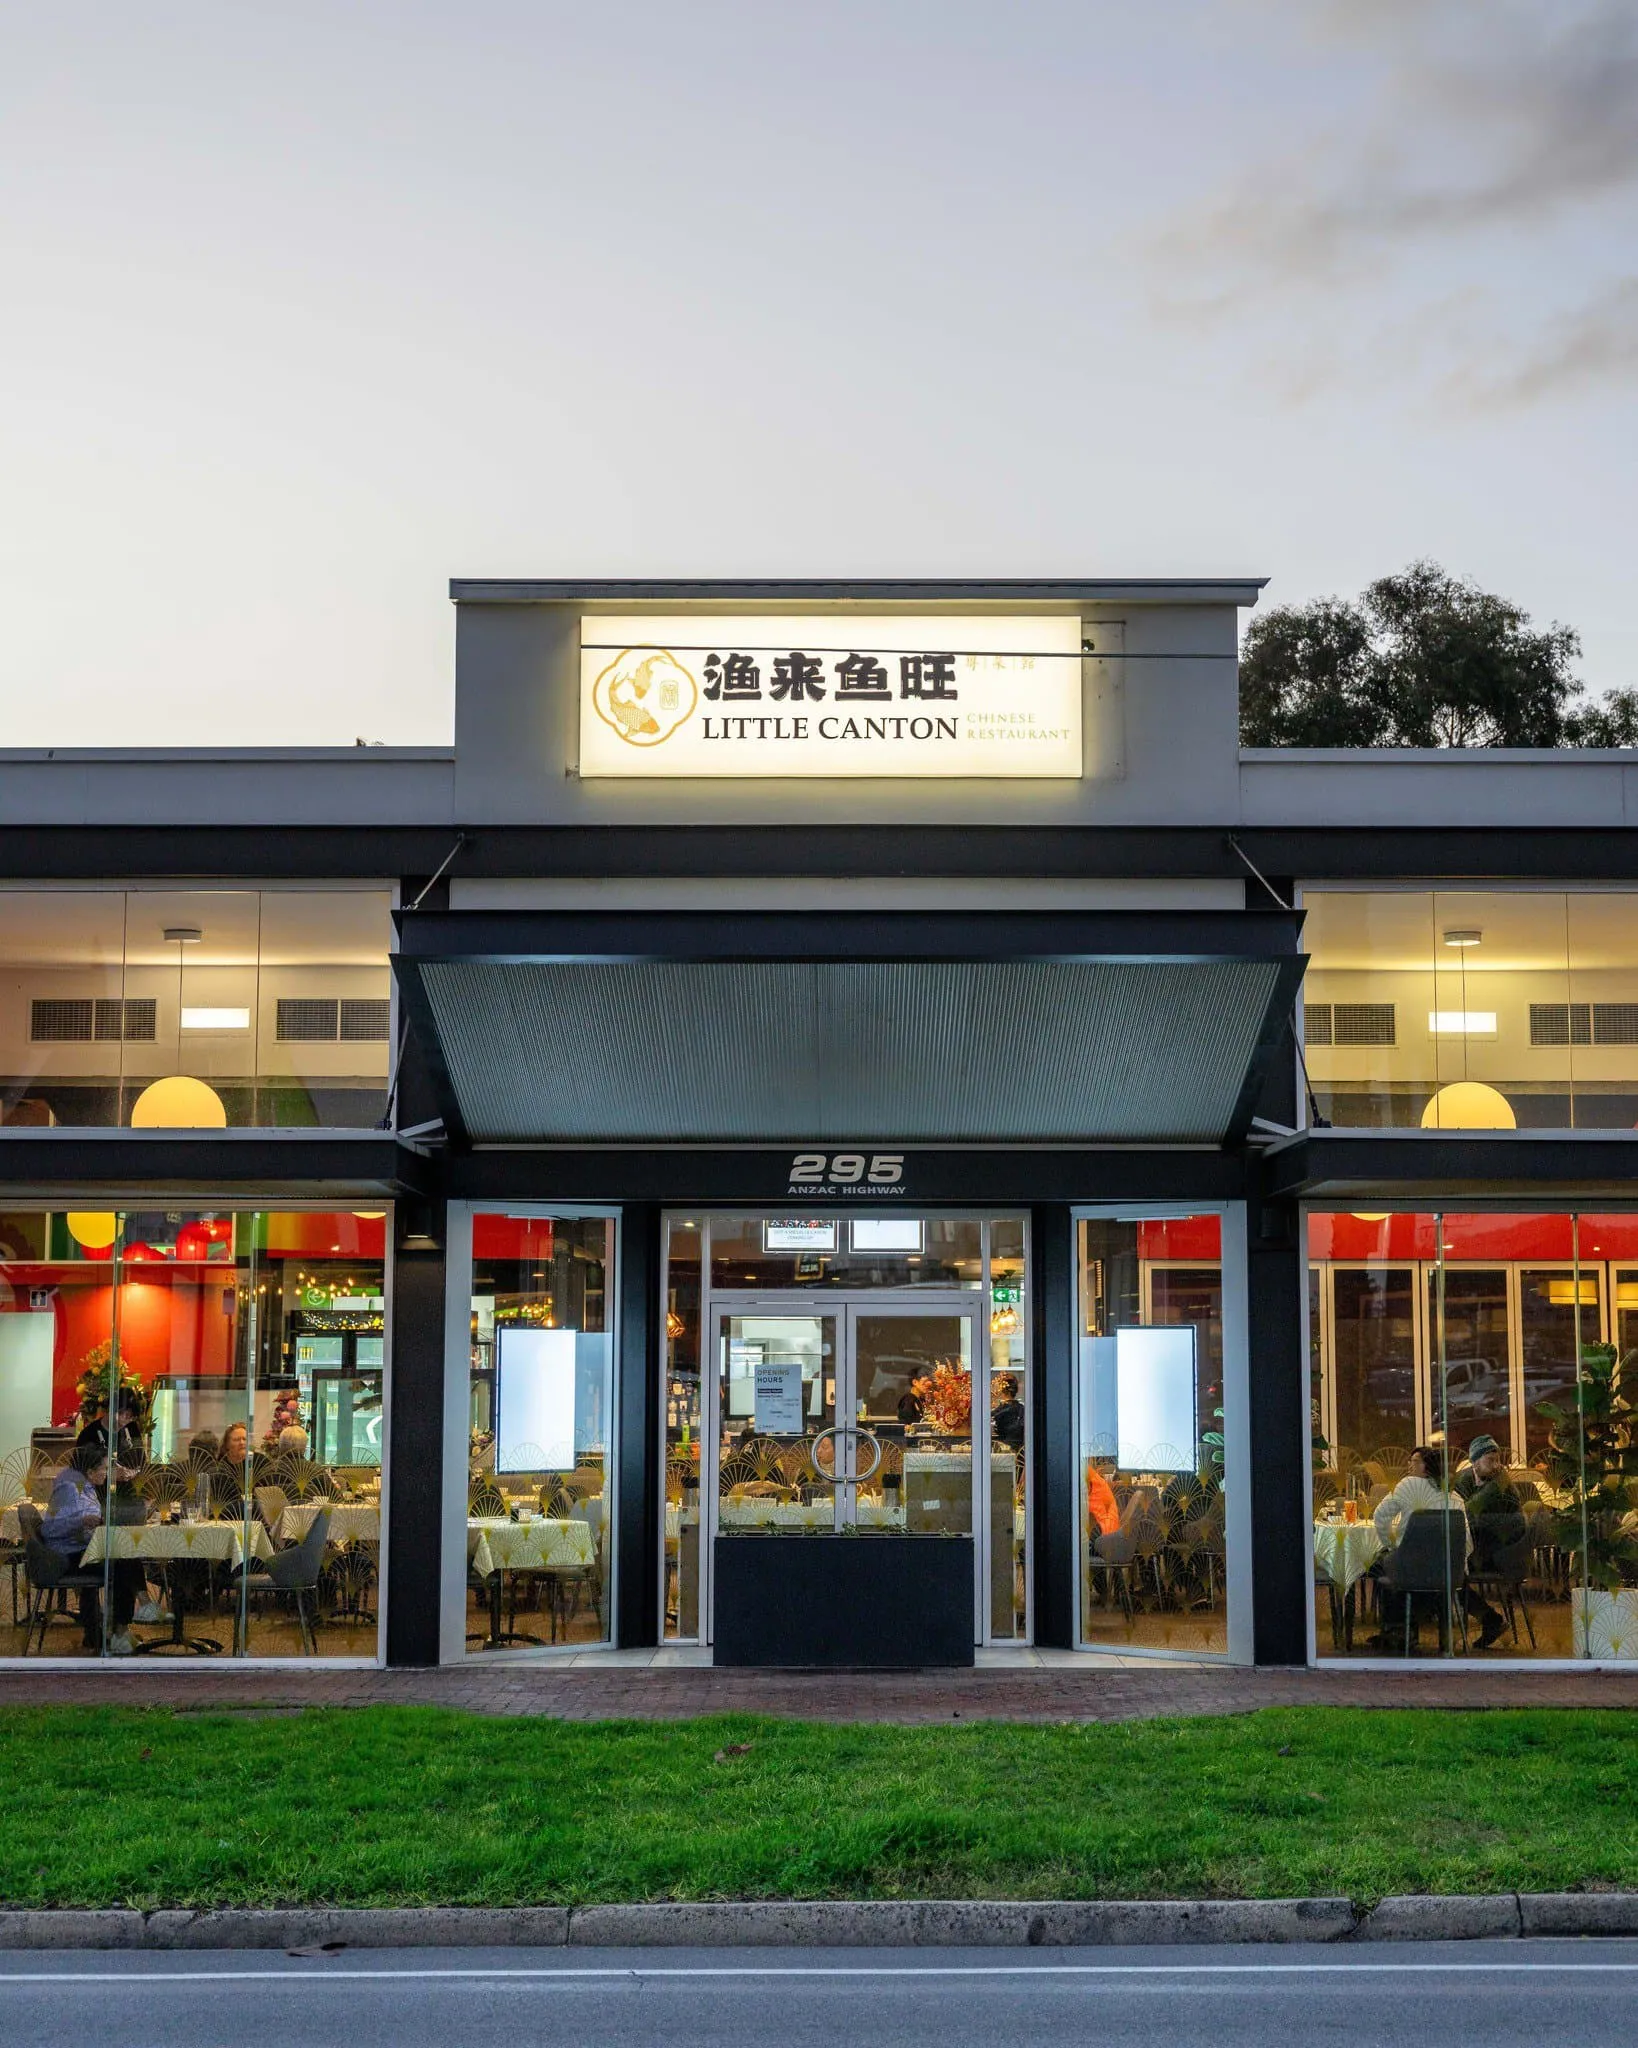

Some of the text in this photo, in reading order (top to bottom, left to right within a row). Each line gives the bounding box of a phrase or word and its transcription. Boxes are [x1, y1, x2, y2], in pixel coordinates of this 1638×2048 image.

[703, 652, 958, 701] 渔来鱼旺
[966, 712, 1037, 724] CHINESE
[702, 716, 959, 740] LITTLE CANTON
[967, 728, 1071, 740] RESTAURANT
[789, 1154, 905, 1183] 295
[787, 1186, 907, 1194] ANZAC HIGHWAY
